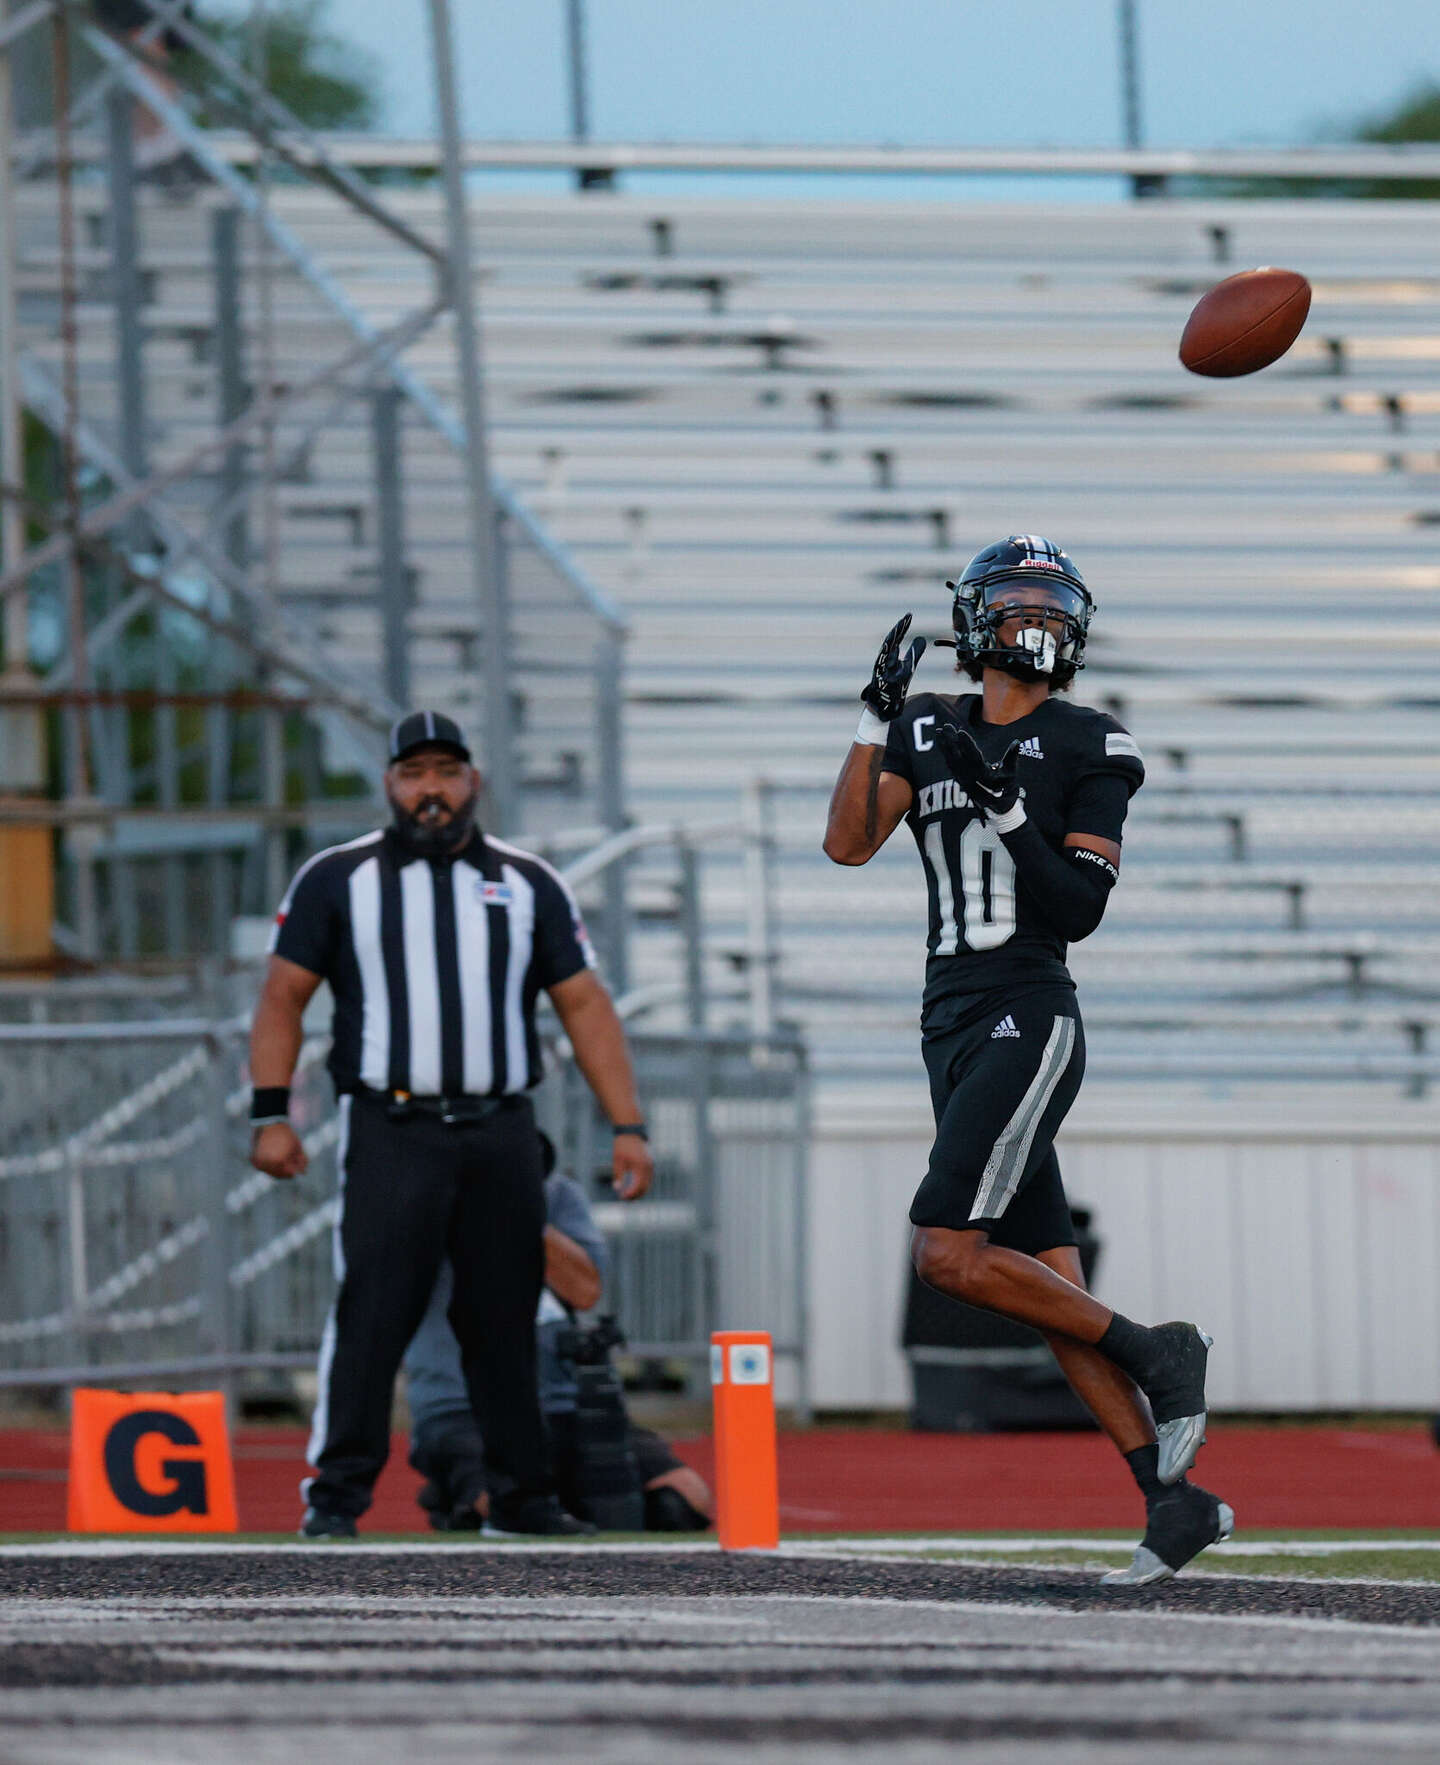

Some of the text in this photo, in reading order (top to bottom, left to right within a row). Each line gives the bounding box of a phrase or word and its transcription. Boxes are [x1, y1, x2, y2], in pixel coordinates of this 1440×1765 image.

[1025, 560, 1060, 570] Riddell
[912, 714, 936, 752] C
[1075, 850, 1119, 880] NIKE PR
[924, 818, 1017, 956] 10
[991, 1028, 1021, 1039] adidas
[104, 1410, 210, 1517] G
